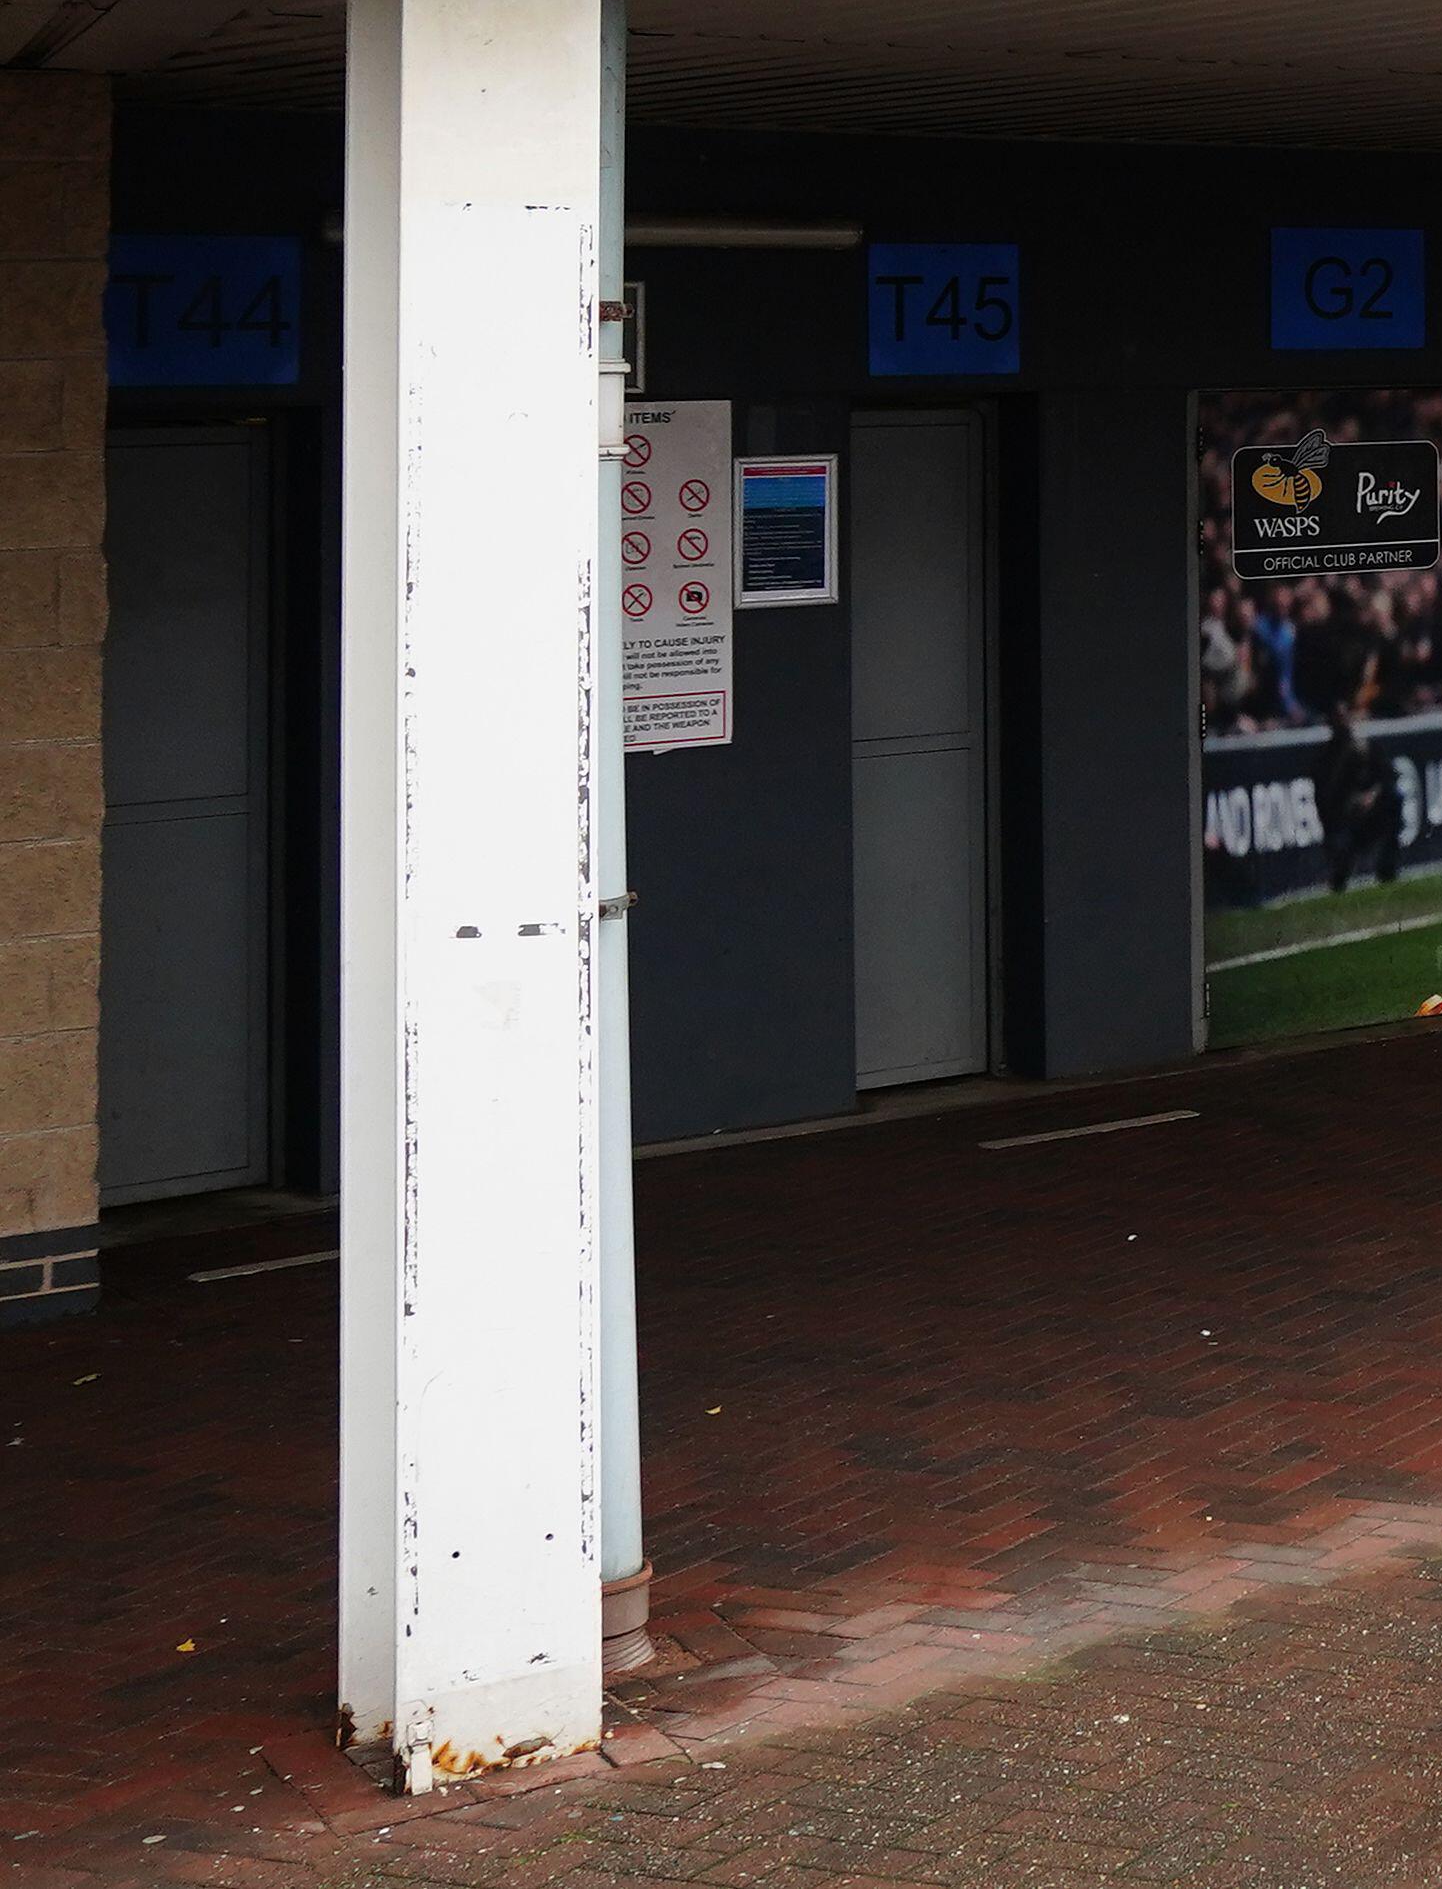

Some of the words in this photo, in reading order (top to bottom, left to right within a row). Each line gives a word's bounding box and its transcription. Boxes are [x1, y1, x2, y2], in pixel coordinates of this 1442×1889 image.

[1304, 255, 1395, 320] G2
[112, 273, 291, 349] T44
[874, 274, 1014, 343] T45
[629, 411, 672, 424] ITEMS
[1357, 471, 1421, 524] Purity
[1254, 515, 1321, 538] WASPS
[1264, 556, 1320, 572] OFFICIAL
[1323, 552, 1355, 567] CLUB
[1359, 550, 1413, 565] PARTNER
[639, 639, 652, 649] TO
[654, 637, 688, 648] CAUSE
[690, 635, 726, 646] INJURY
